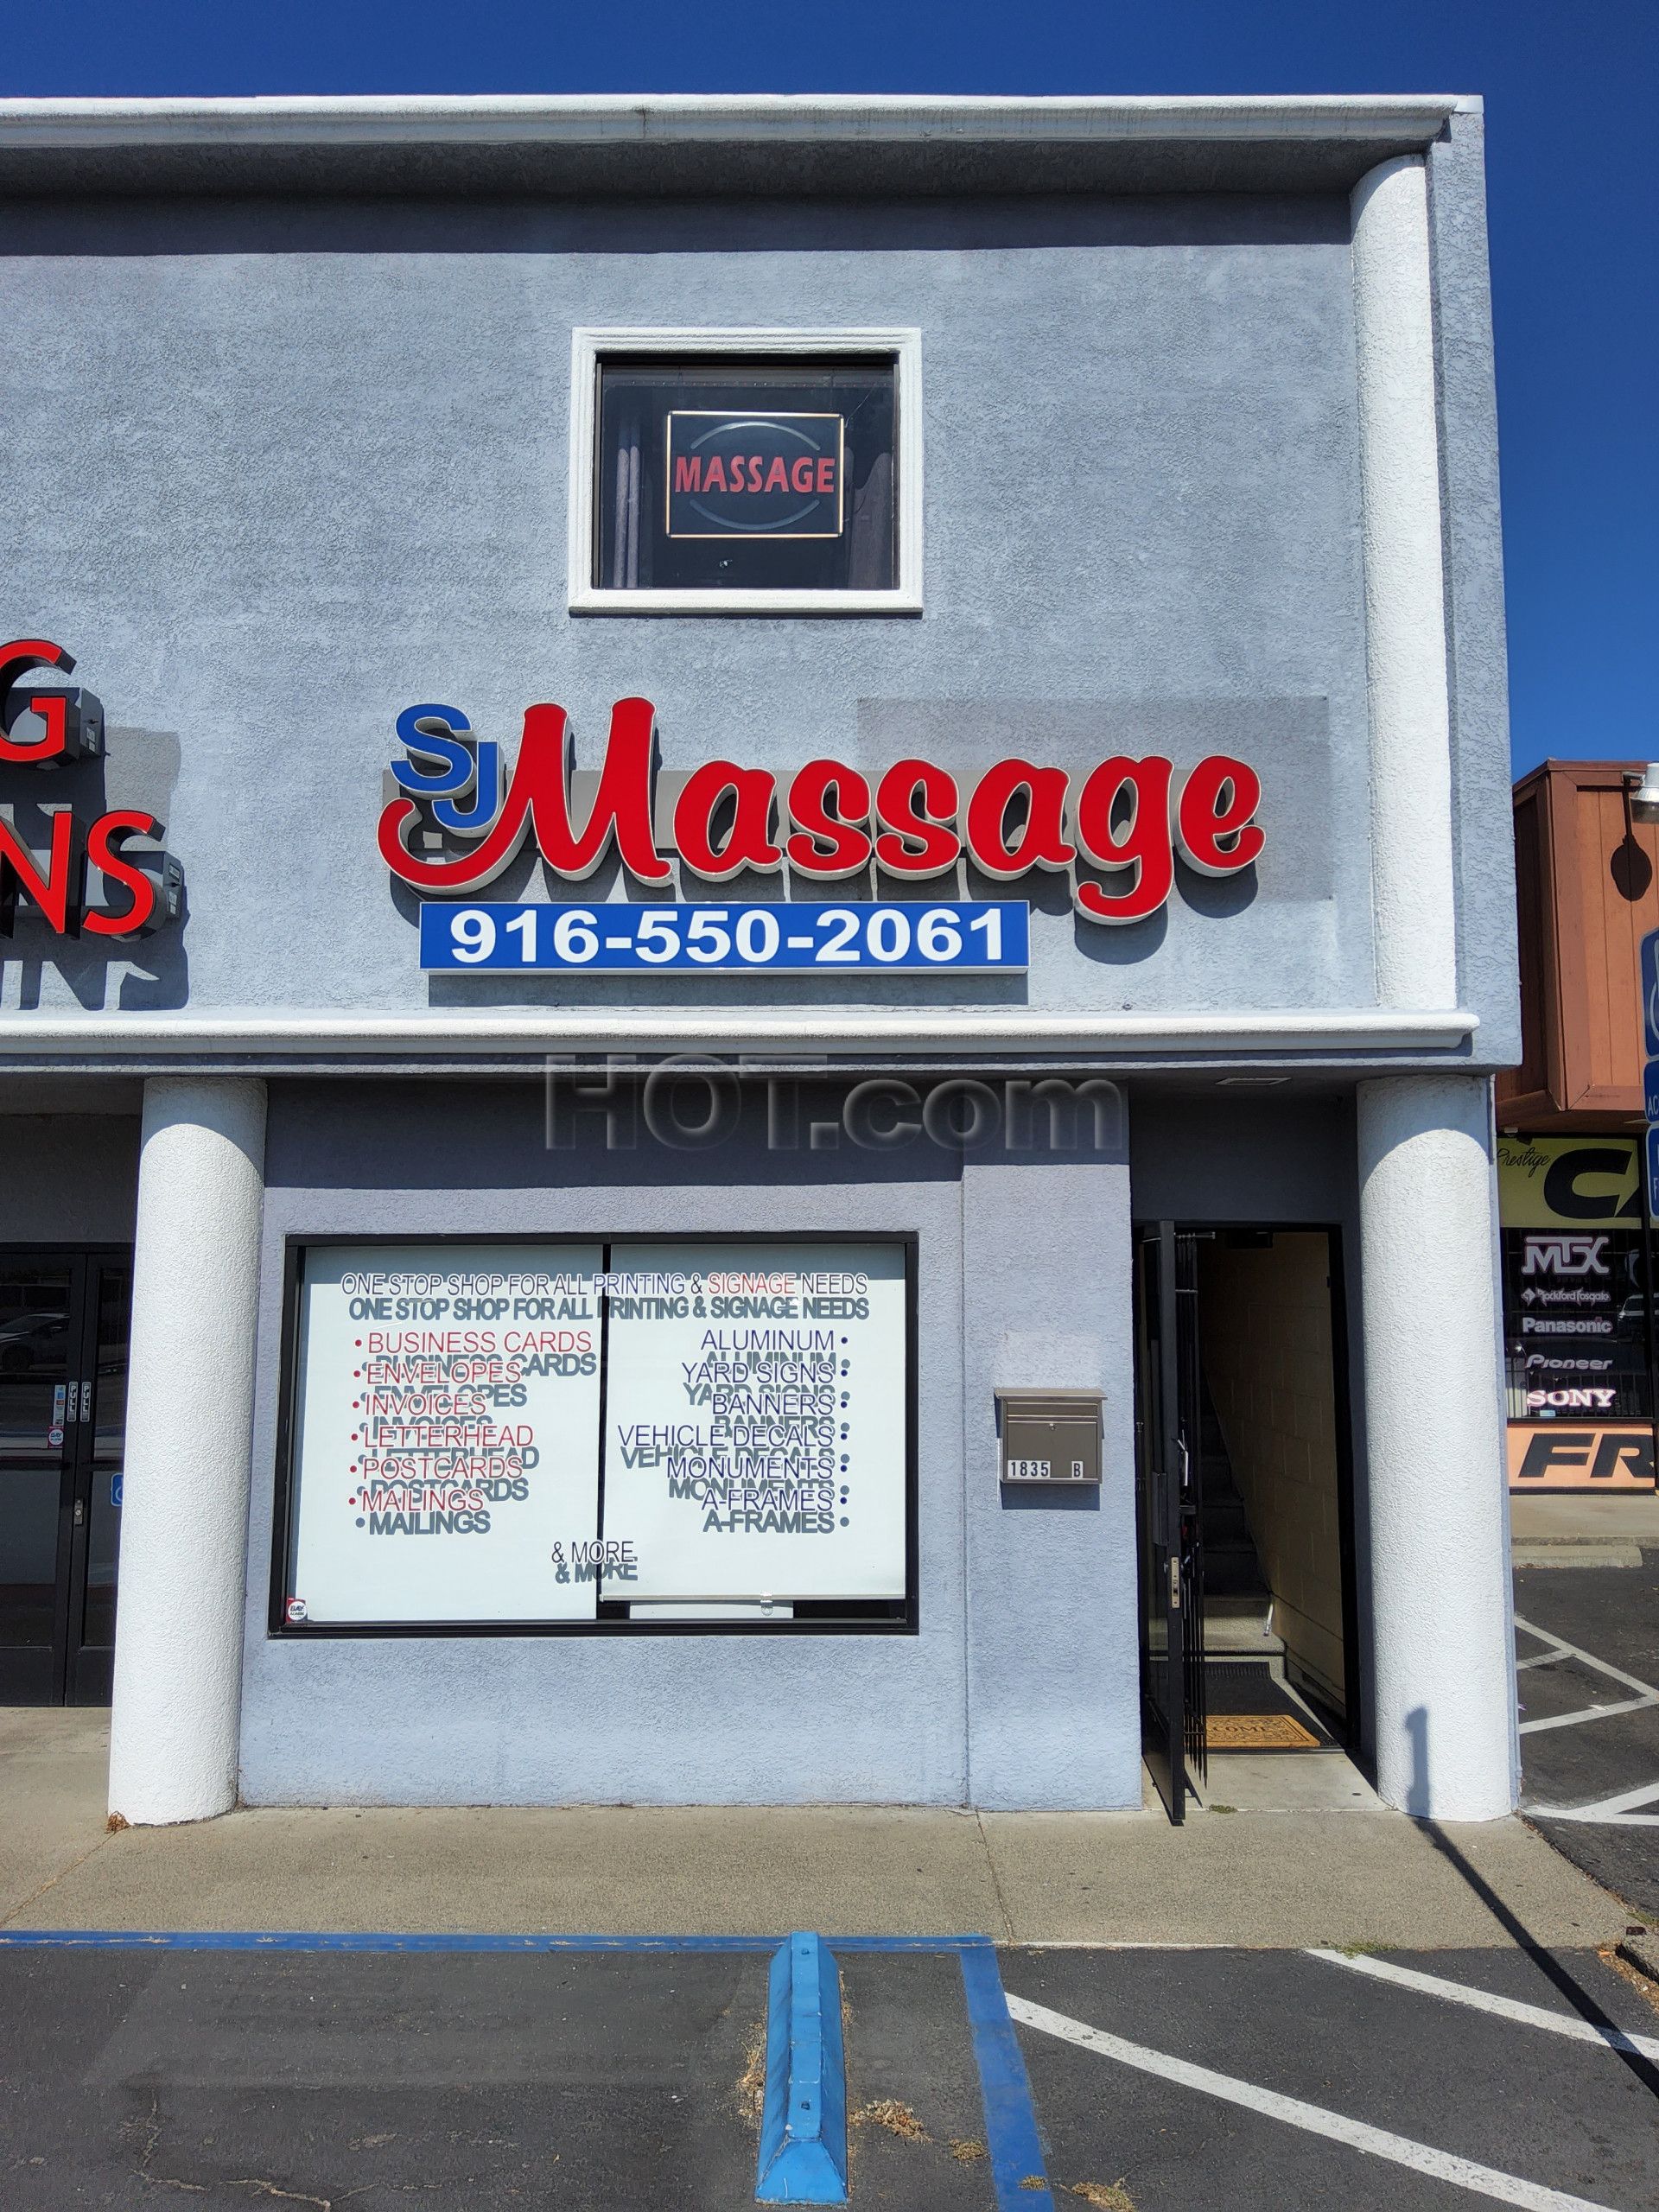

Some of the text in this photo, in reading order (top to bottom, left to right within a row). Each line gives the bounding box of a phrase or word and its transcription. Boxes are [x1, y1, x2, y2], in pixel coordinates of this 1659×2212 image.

[676, 455, 836, 493] MASSAGE
[377, 696, 1267, 921] SJ Massage
[450, 908, 1002, 963] 916-550-2061
[1497, 1147, 1551, 1178] Prestige
[1521, 1236, 1610, 1274] MTX
[342, 1273, 868, 1296] ONE STOP SHOP FOR ALL PRINTING & SIGNAGE NEEDS
[1522, 1317, 1613, 1333] Panasonic
[368, 1331, 592, 1354] BUSINESS CARDS
[701, 1330, 834, 1351] ALUMINUM
[366, 1362, 521, 1384] ENVELOPES
[681, 1362, 834, 1383] YARD SIGNS
[1525, 1354, 1613, 1370] Pioneer
[365, 1393, 486, 1416] INVOICES
[712, 1393, 834, 1415] BANNERS
[1526, 1389, 1617, 1408] SONY
[364, 1425, 534, 1448] LETTERHEAD
[617, 1425, 834, 1447] VEHICLE DECALS
[362, 1457, 524, 1480] POSTCARDS
[666, 1457, 833, 1479] MONUMENTS
[1011, 1461, 1081, 1477] 1835 B
[361, 1489, 485, 1512] MAILINGS
[701, 1488, 833, 1511] A-FRAMES
[551, 1541, 634, 1563] & MORE
